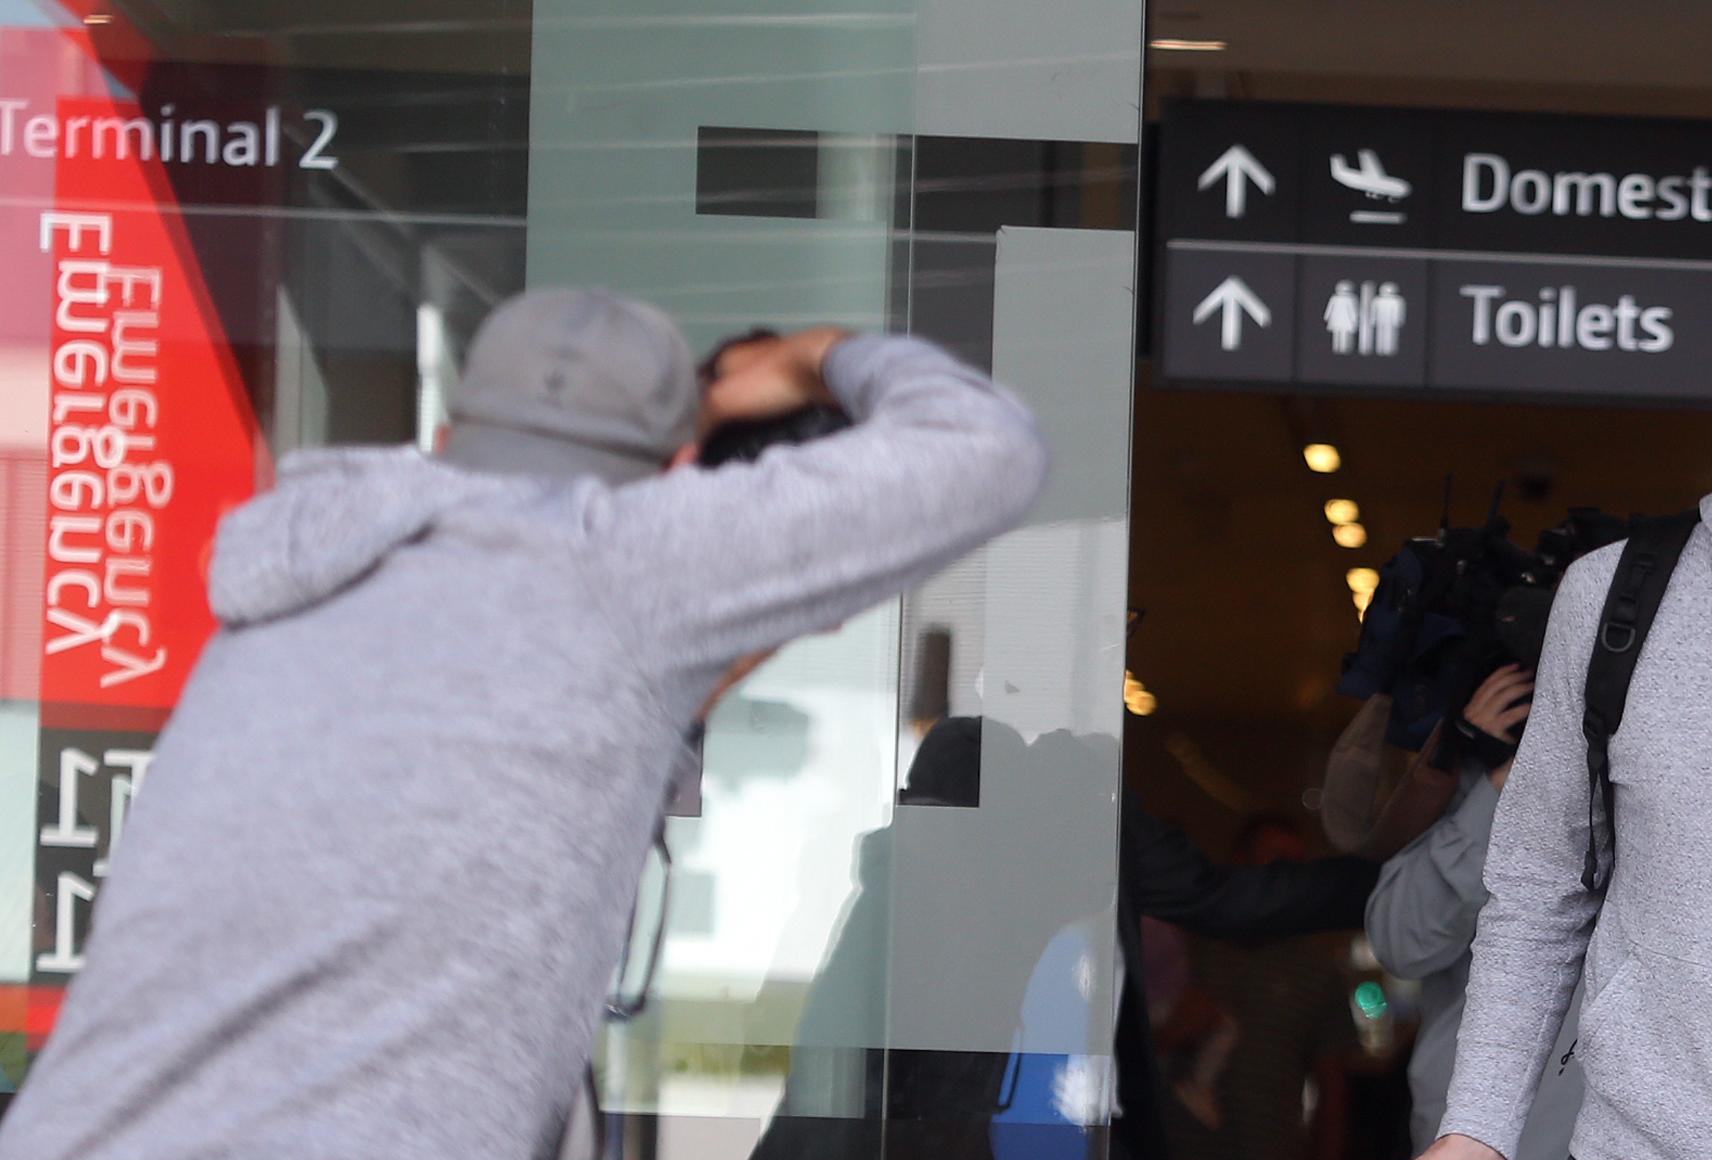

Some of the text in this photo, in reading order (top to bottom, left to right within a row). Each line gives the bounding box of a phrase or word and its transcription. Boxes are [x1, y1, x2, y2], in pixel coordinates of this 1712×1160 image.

[0, 98, 340, 171] Terminal 2
[1459, 284, 1676, 354] Toilets
